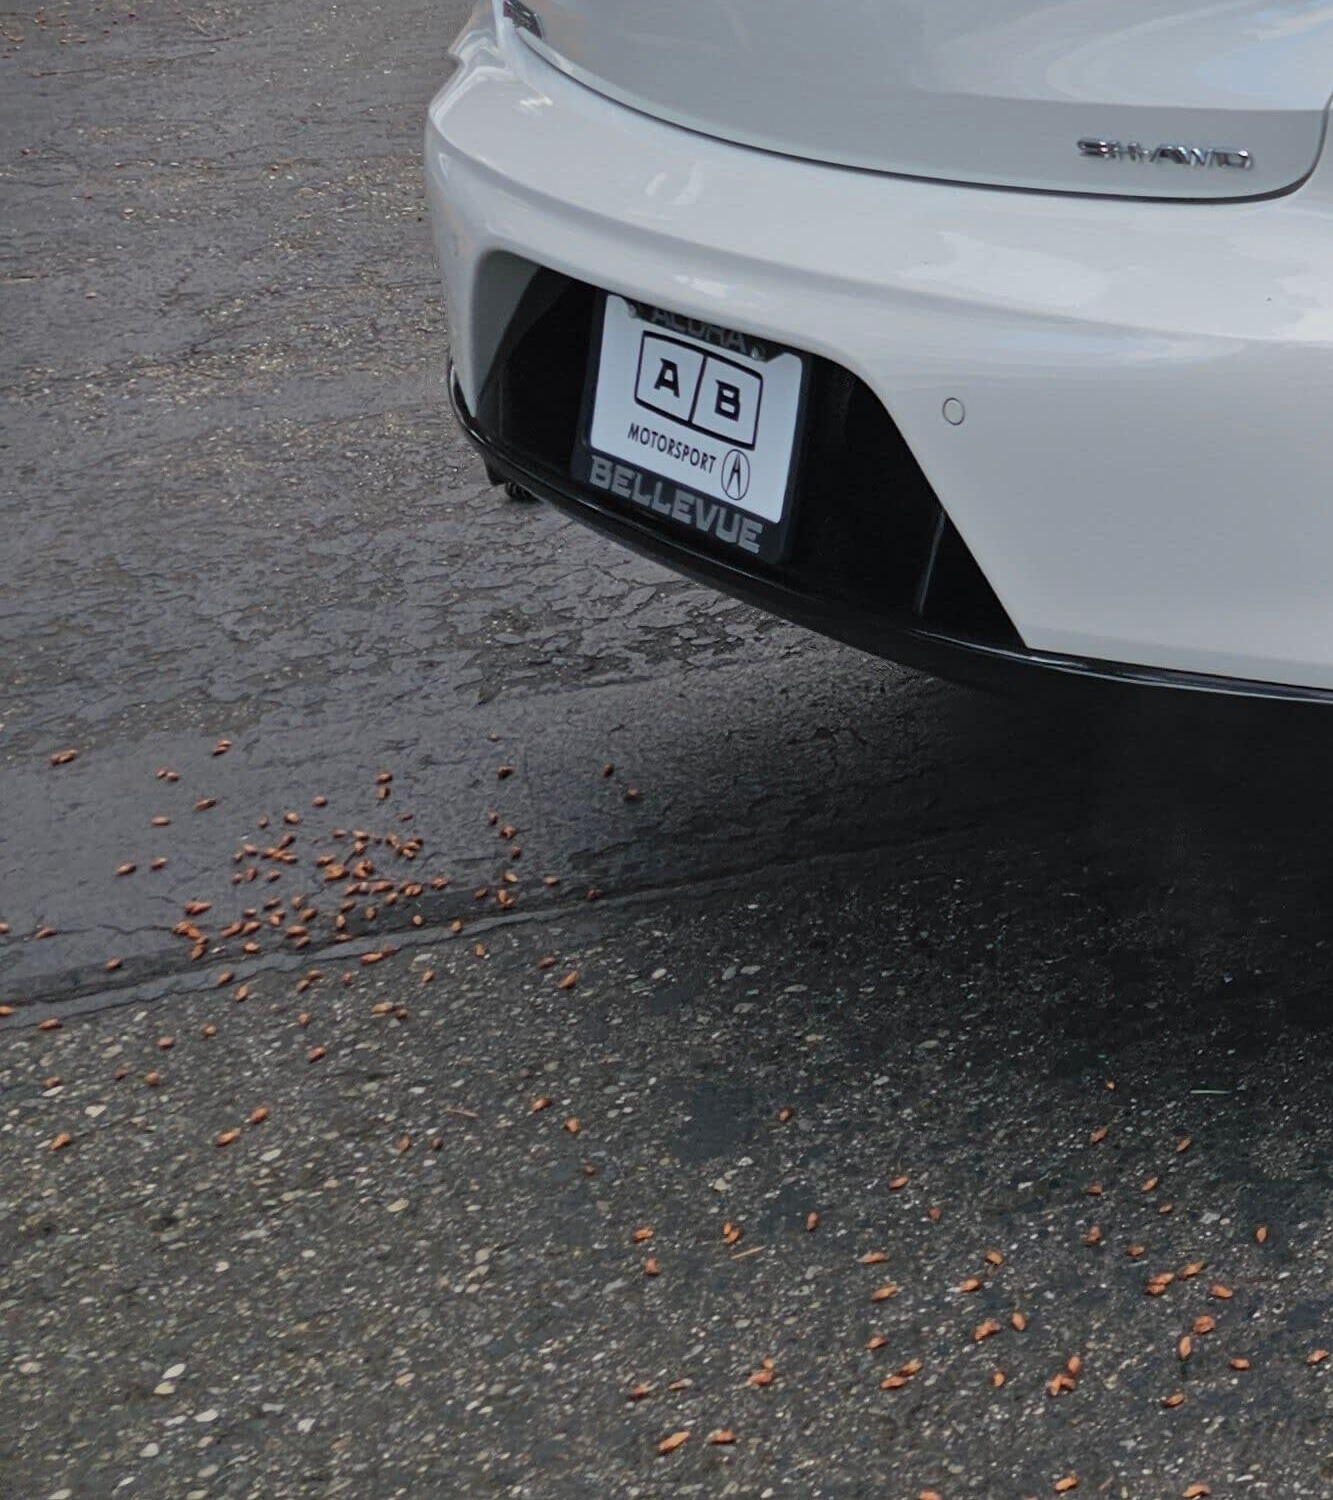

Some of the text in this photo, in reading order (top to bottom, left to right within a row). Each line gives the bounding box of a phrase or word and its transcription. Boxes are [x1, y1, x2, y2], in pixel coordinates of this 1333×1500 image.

[1077, 138, 1255, 171] SH-AWD
[653, 357, 741, 423] A B
[627, 421, 718, 475] MOTORSPORT
[588, 453, 764, 556] BELLEVUE
